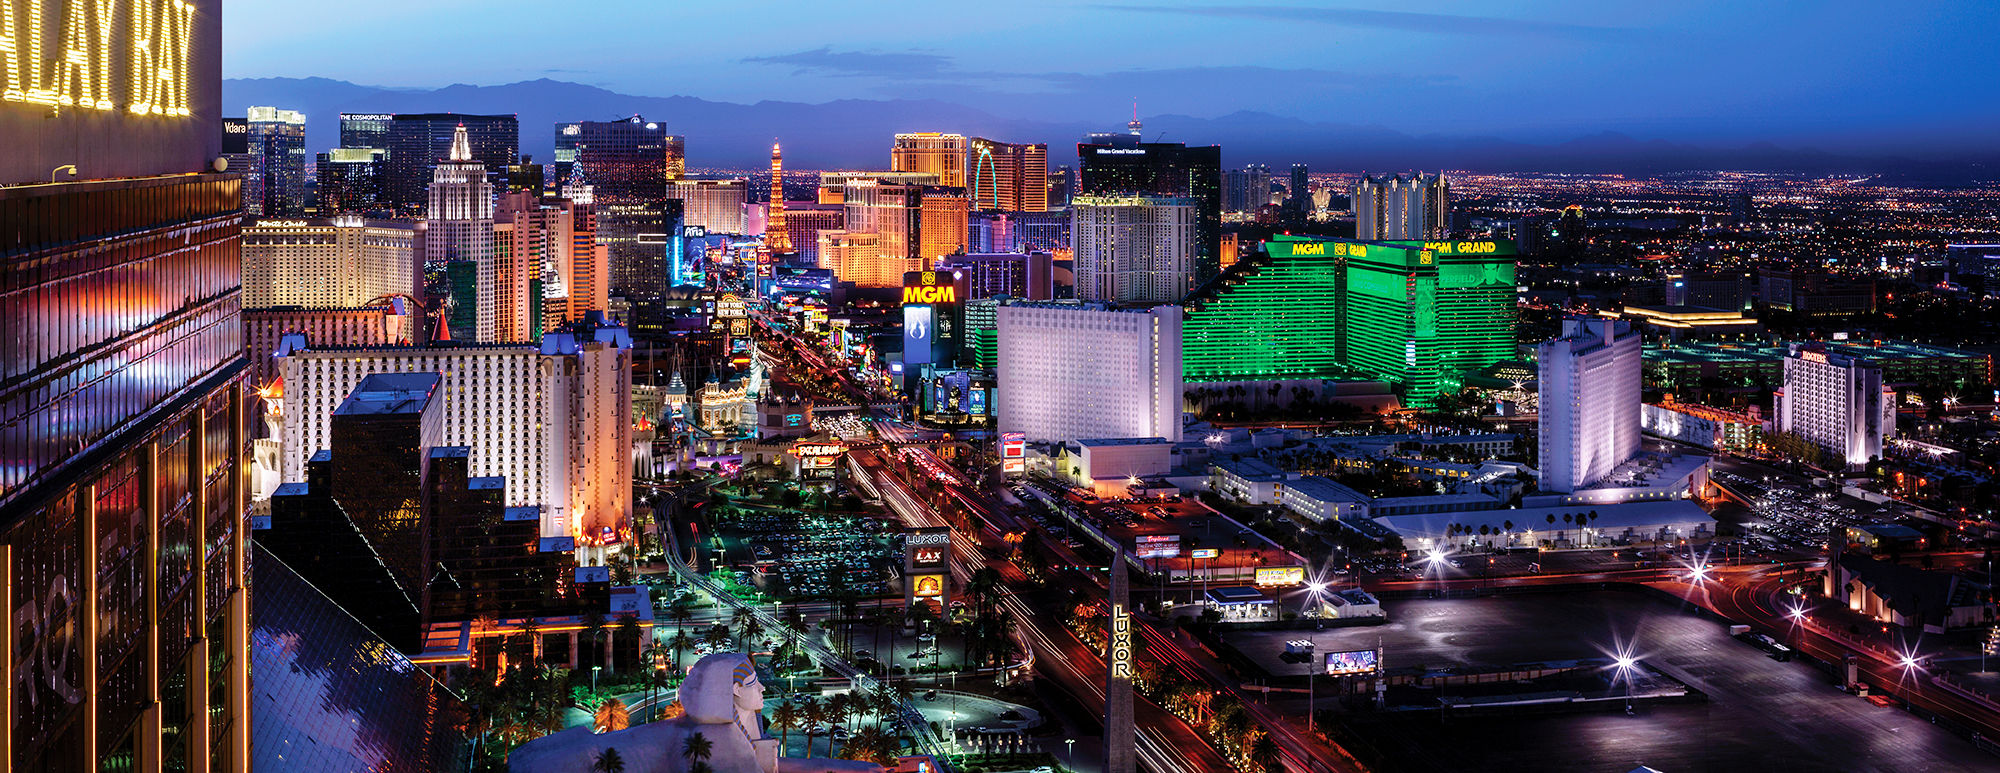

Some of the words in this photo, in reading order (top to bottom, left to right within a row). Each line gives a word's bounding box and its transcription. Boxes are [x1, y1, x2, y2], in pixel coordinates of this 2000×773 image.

[129, 0, 195, 117] BAY
[224, 121, 246, 134] Vdara
[846, 178, 877, 189] hollywood
[1292, 243, 1325, 256] MGM
[1349, 244, 1367, 257] GRAND
[1424, 242, 1452, 253] MGM
[1457, 241, 1496, 253] GRAND
[903, 285, 955, 303] MGM
[1802, 350, 1827, 364] HOOTERS
[799, 445, 840, 456] EXCALIBUR
[905, 534, 950, 545] LUXOR
[916, 551, 941, 560] LAX
[1114, 605, 1131, 677] LUXOR
